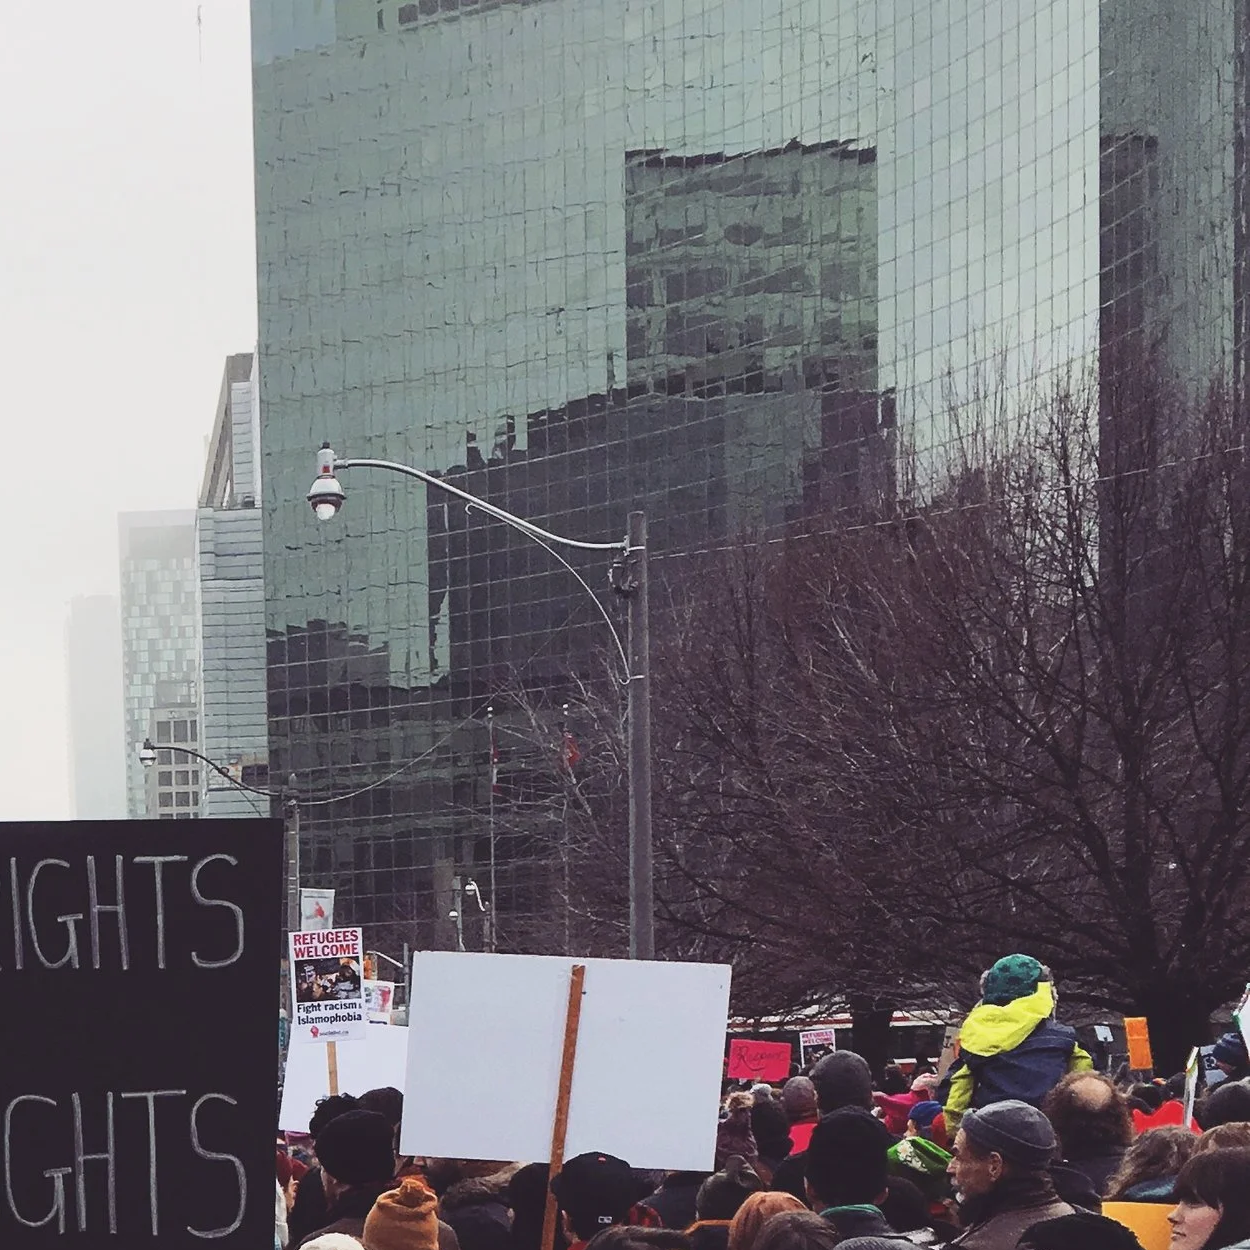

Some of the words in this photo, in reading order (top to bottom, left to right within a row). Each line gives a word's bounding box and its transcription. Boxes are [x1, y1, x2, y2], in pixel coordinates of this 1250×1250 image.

[293, 930, 359, 946] REFUGEES
[294, 943, 359, 959] WELCOME
[297, 1003, 322, 1014] Fight
[324, 1002, 357, 1011] racism
[297, 1011, 362, 1025] Islamophobia
